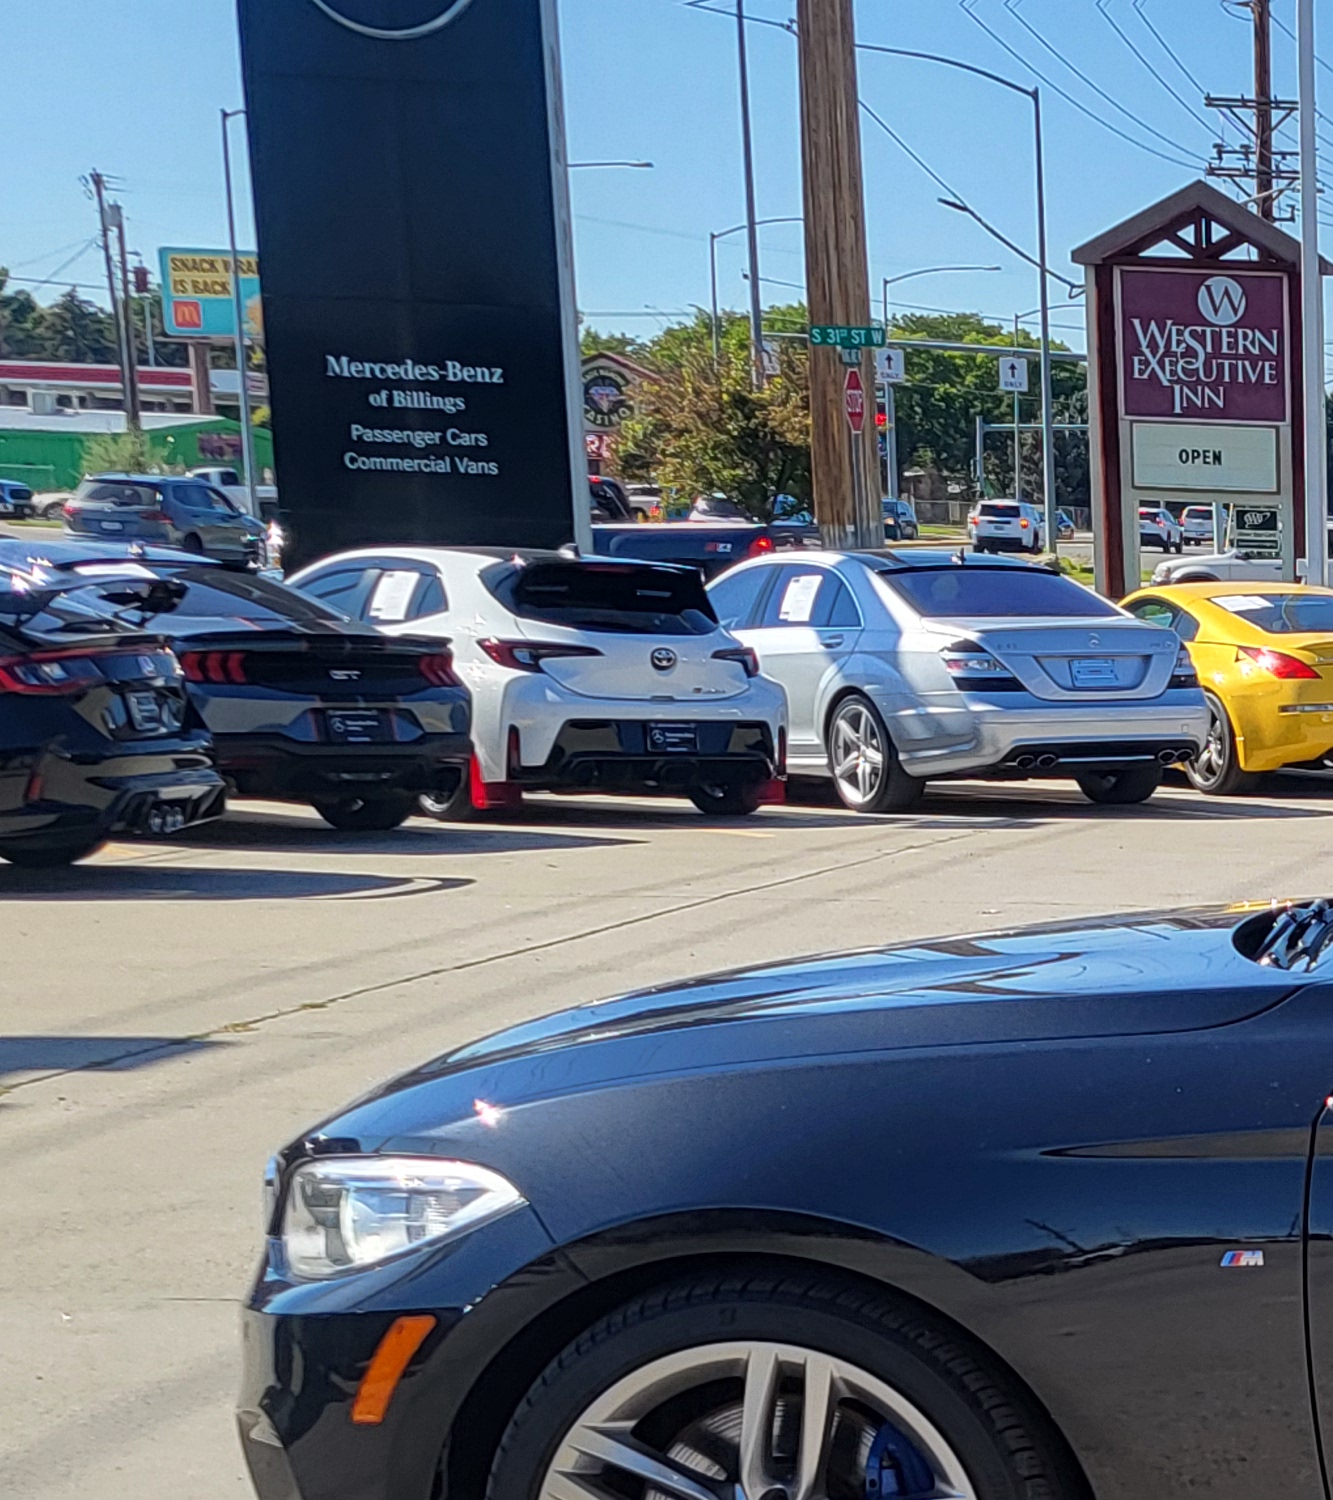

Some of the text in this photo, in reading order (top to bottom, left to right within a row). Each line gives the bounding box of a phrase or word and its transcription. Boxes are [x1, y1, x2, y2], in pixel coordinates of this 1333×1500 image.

[171, 257, 219, 273] SNACK
[173, 279, 231, 296] IS BACK
[1204, 284, 1245, 318] W
[811, 328, 822, 344] S
[850, 329, 867, 345] ST
[871, 330, 883, 344] W
[1130, 318, 1279, 357] WESTERN
[325, 354, 504, 383] Mercedes-Benz
[880, 371, 900, 380] ONLY
[1131, 347, 1278, 385] EXECUTIVE
[1004, 380, 1023, 388] ONLY
[368, 389, 467, 414] of Billings
[1173, 384, 1224, 414] INN
[351, 423, 489, 448] Passenger Cars
[344, 452, 500, 475] Commercial Vans
[1178, 448, 1222, 466] OPEN
